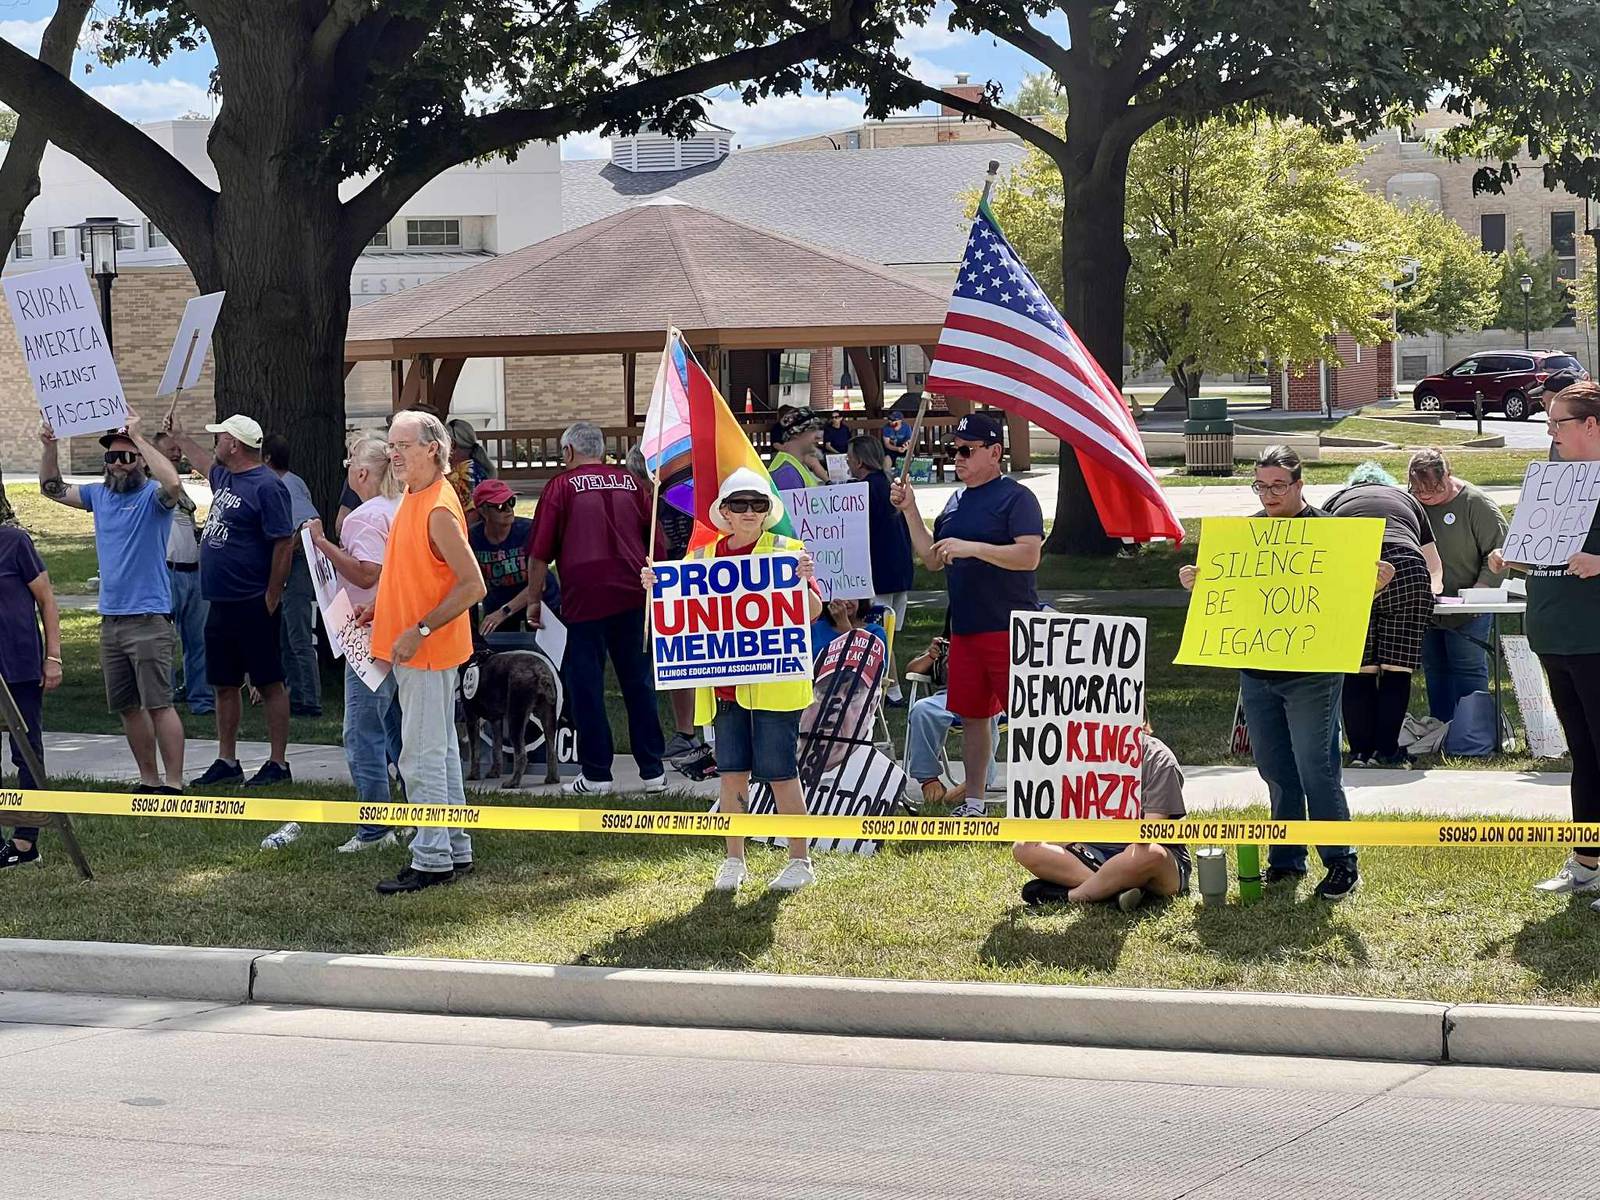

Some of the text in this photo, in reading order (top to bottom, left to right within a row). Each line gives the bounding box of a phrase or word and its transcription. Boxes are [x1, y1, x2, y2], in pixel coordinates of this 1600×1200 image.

[16, 283, 86, 321] RURAL
[23, 325, 103, 363] AMERICA
[40, 364, 98, 393] AGAINST
[45, 394, 126, 428] FASCISM
[569, 474, 638, 493] VELLA
[1521, 462, 1600, 506] PEOPLE
[792, 488, 865, 516] Mexicans
[1249, 519, 1313, 547] WILL
[1528, 505, 1588, 533] OVER
[1501, 531, 1589, 564] PROFIT
[652, 556, 801, 599] PROUD
[1205, 550, 1328, 581] SILENCE
[816, 568, 867, 602] nywhere
[1204, 585, 1321, 616] BE YOUR
[653, 590, 806, 636] UNION
[655, 627, 808, 664] MEMBER
[1011, 616, 1142, 670] DEFEND
[1198, 624, 1317, 657] LEGACY?
[659, 656, 805, 678] ILLINOIS EDUCATION ASSOCIATION IEA
[1011, 673, 1143, 719] DEMOCRACY
[1012, 720, 1143, 769] NO KINGS
[131, 798, 245, 814] POLICE LINE DO NOT CROSS
[1013, 771, 1142, 819] NO NAZIS
[359, 806, 480, 823] POLICE LINE DO NOT CROSS
[602, 813, 731, 830] POLICE LINE DO NOT CROSS
[862, 820, 1000, 836] POLICE LINE DO NOT CROSS
[1140, 823, 1287, 839] POLICE LINE DO NOT CROSS
[1439, 826, 1600, 843] POLICE LINE DO NOT CROSS
